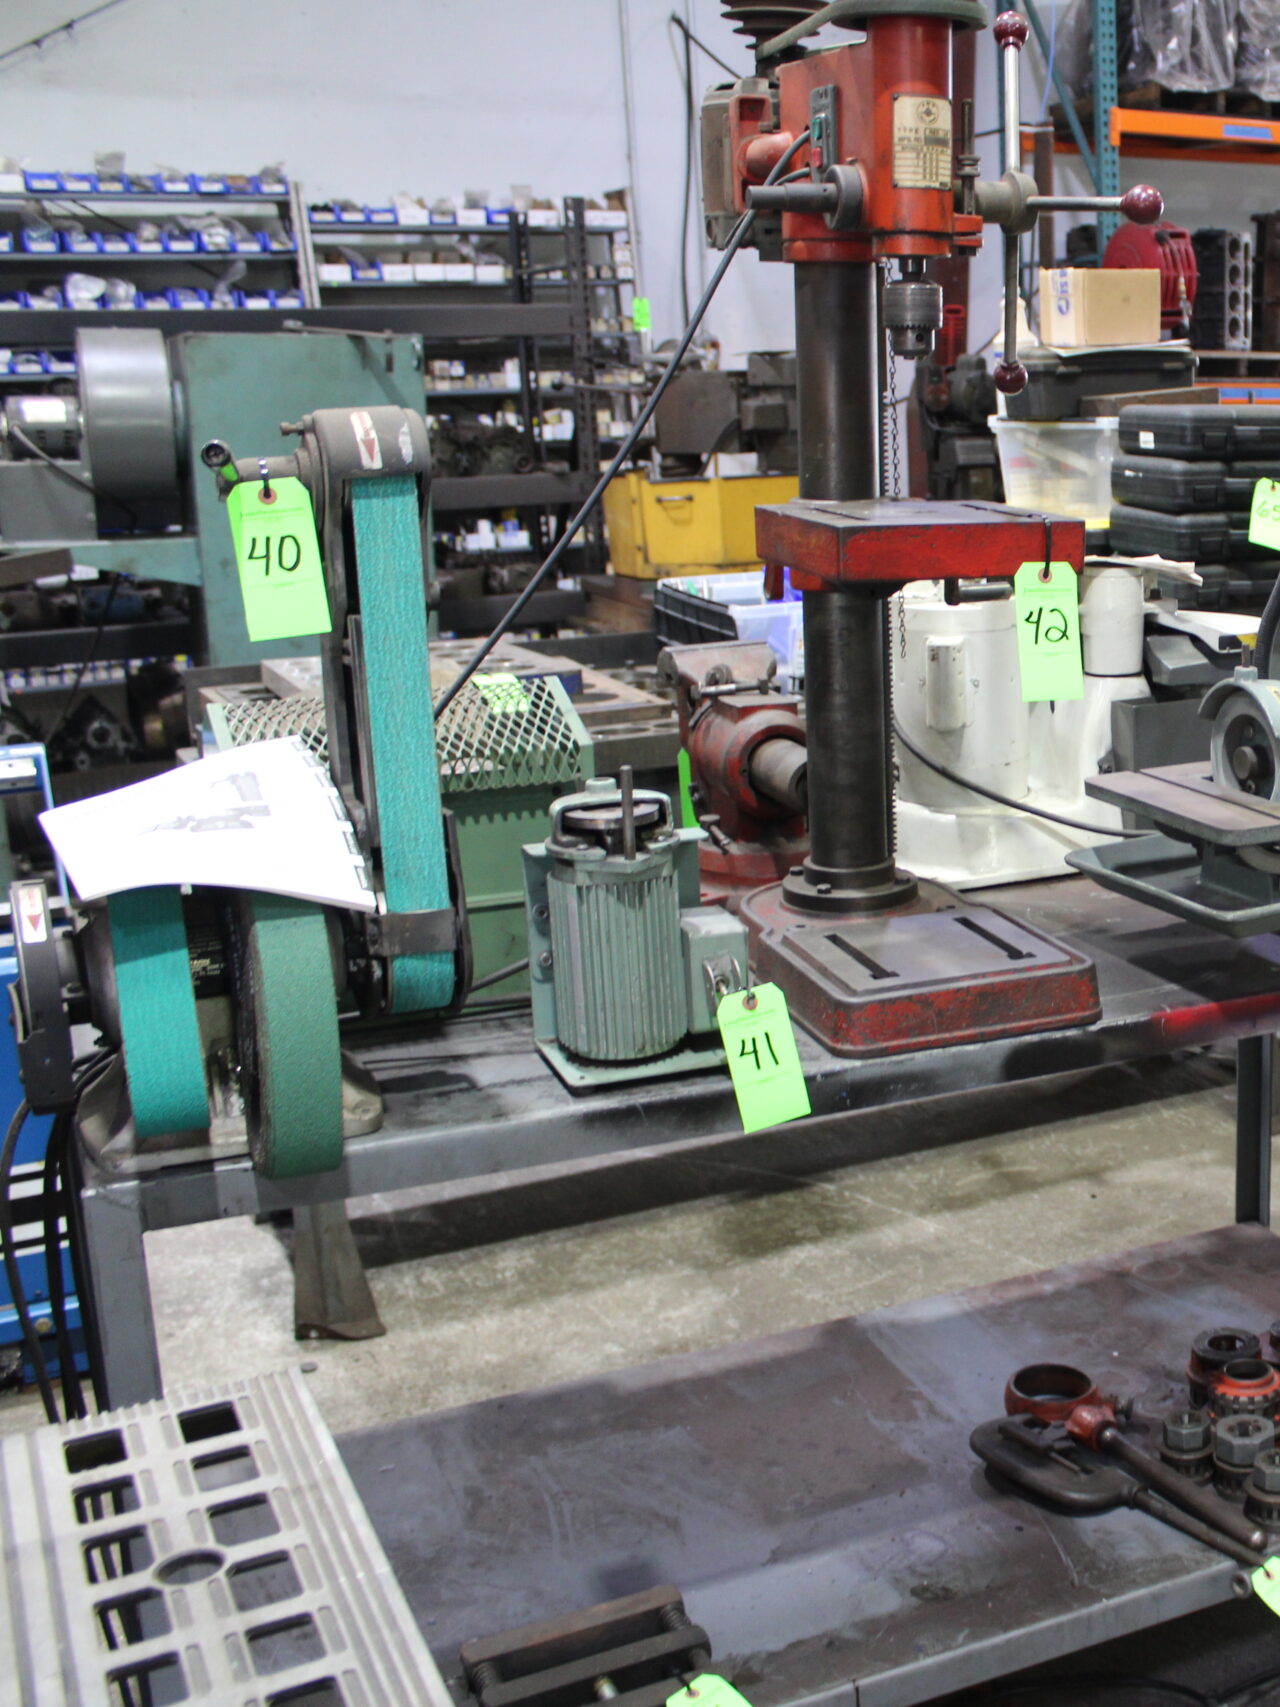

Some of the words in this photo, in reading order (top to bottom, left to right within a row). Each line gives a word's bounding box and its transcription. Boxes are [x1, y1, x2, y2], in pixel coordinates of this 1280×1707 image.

[247, 534, 302, 577] 40
[1024, 606, 1069, 645] 42
[739, 1032, 779, 1070] 41
